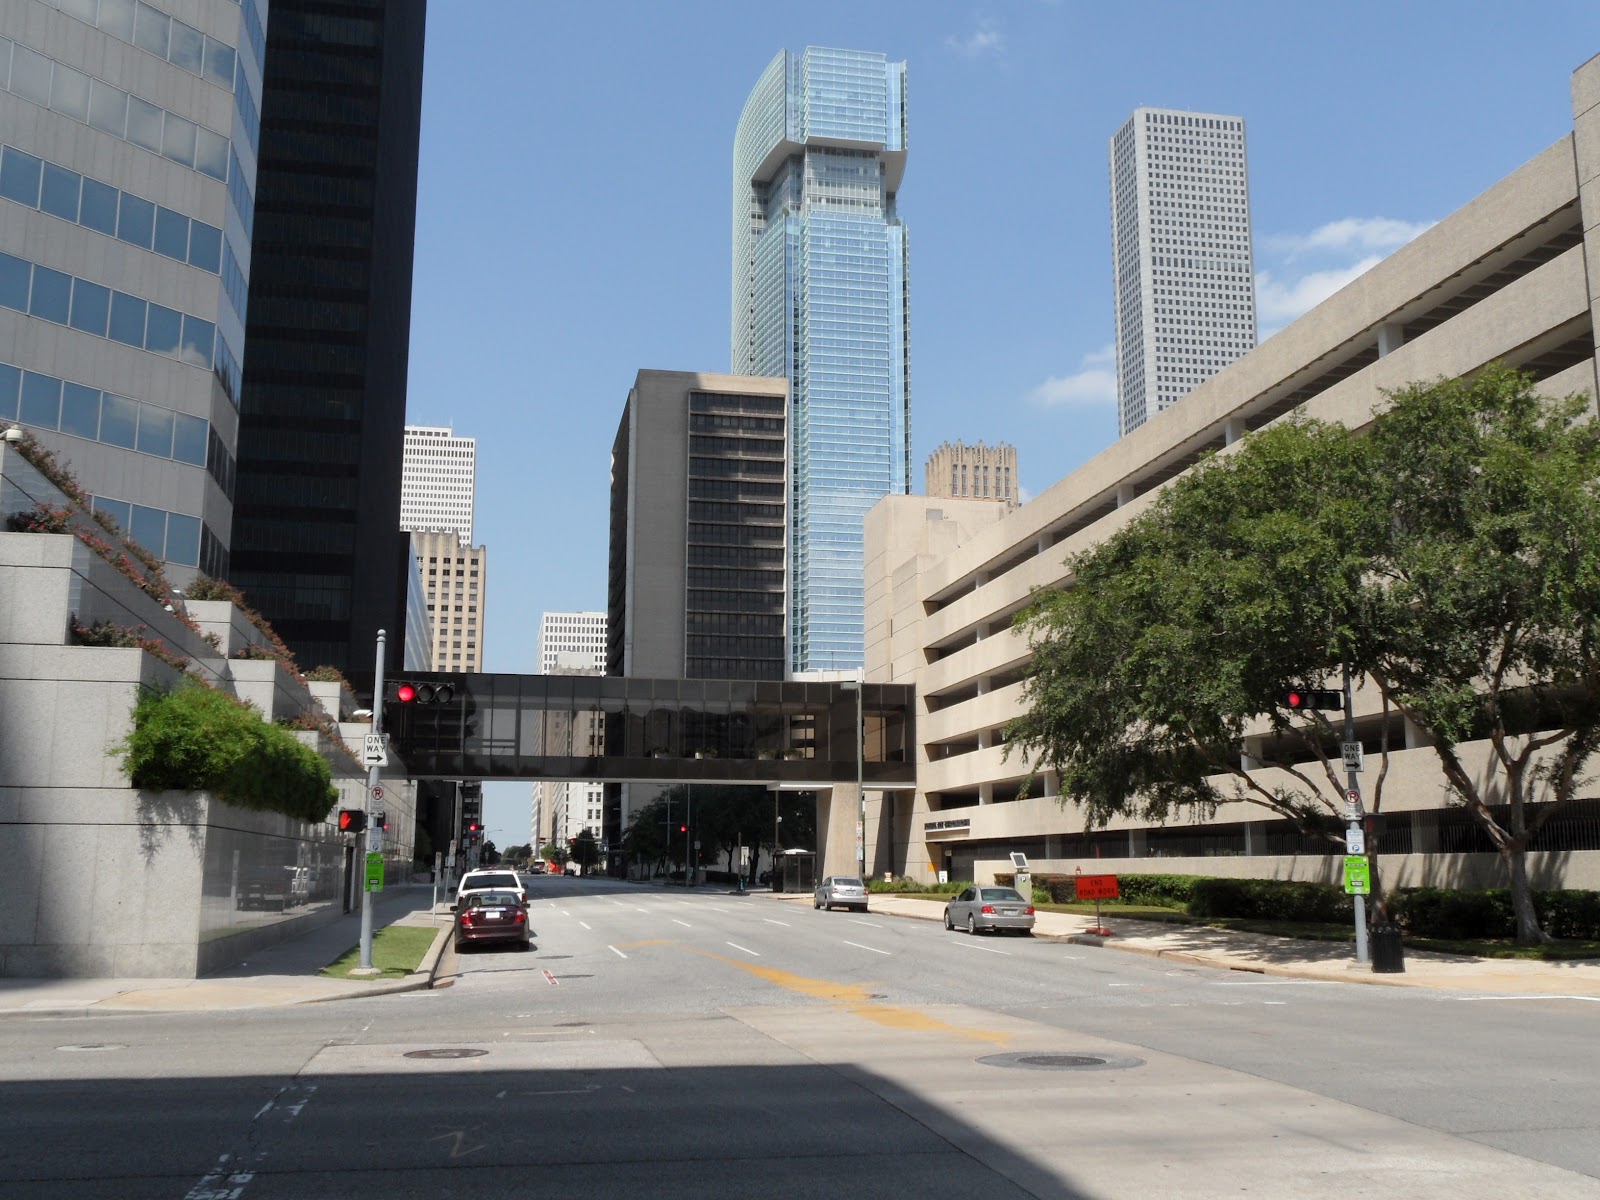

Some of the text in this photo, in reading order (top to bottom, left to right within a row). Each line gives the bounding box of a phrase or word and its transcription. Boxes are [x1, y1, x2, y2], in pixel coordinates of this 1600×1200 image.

[367, 736, 386, 744] ONE
[366, 745, 386, 753] WAY
[1344, 744, 1360, 752] ONE
[1090, 879, 1104, 887] END
[1079, 889, 1096, 897] ROAD
